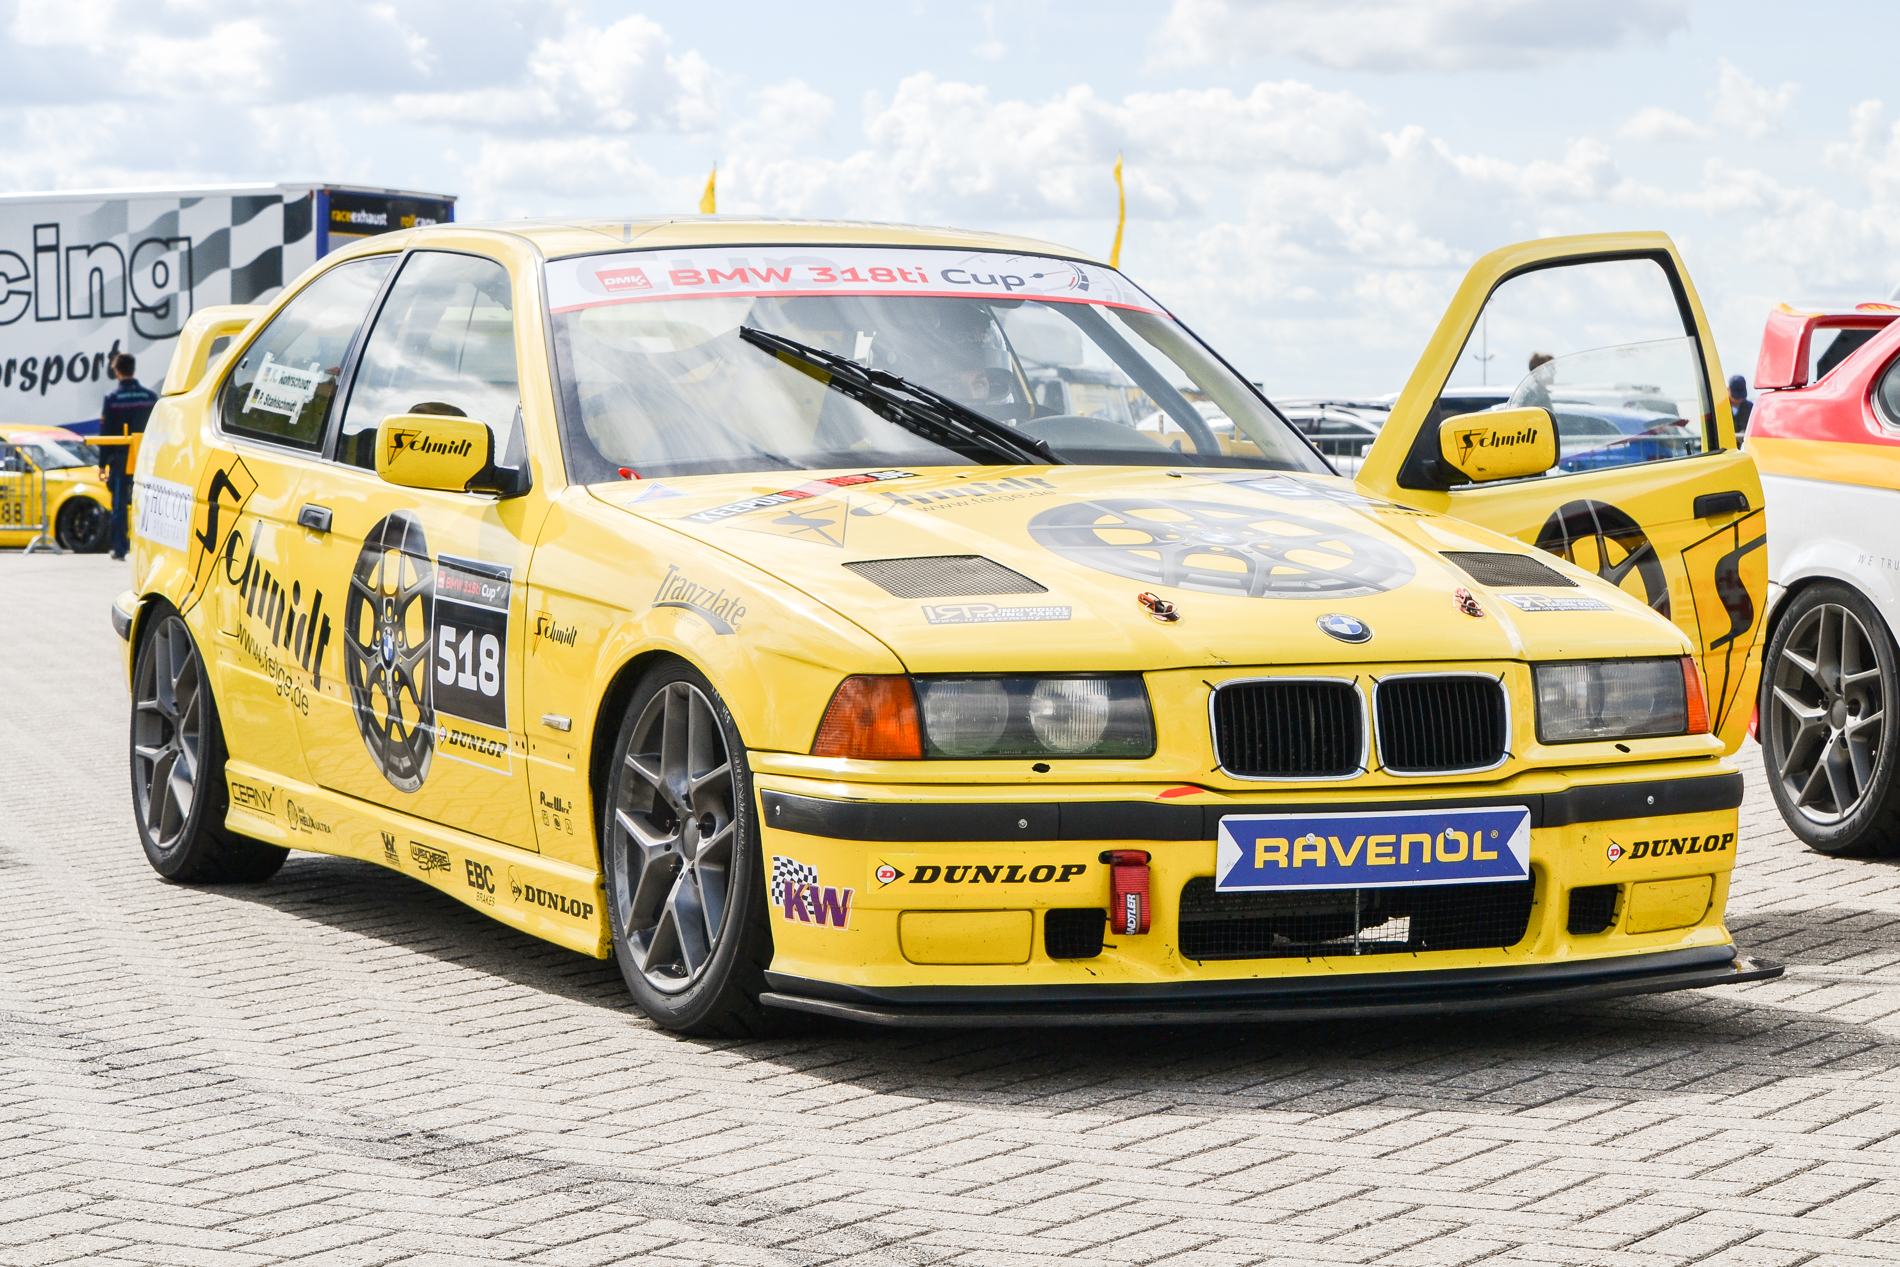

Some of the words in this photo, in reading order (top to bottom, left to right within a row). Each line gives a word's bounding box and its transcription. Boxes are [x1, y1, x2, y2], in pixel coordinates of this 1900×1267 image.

[668, 267, 792, 286] BMW
[808, 266, 929, 284] 318ti
[940, 268, 1026, 291] Cup
[0, 339, 121, 396] rsport
[390, 433, 472, 457] Schmidt
[1459, 428, 1538, 448] Schmidt
[918, 489, 1057, 513] www.felge.de
[1858, 554, 1874, 566] WE
[195, 468, 332, 692] Schmidt
[446, 576, 463, 591] BMW
[482, 583, 496, 601] Cup
[653, 563, 746, 626] Tranzzlate
[534, 616, 577, 648] Schmidt
[931, 614, 1070, 624] www.irp-germany.com
[437, 624, 500, 697] 518
[448, 728, 508, 758] DUNLOP
[1253, 830, 1499, 869] RAVENOL
[1628, 832, 1734, 860] DUNLOP
[465, 858, 495, 894] EBC
[908, 864, 1087, 884] DUNLOP
[476, 891, 496, 907] BRAKES
[524, 884, 594, 920] DUNLOP
[784, 880, 853, 930] KW
